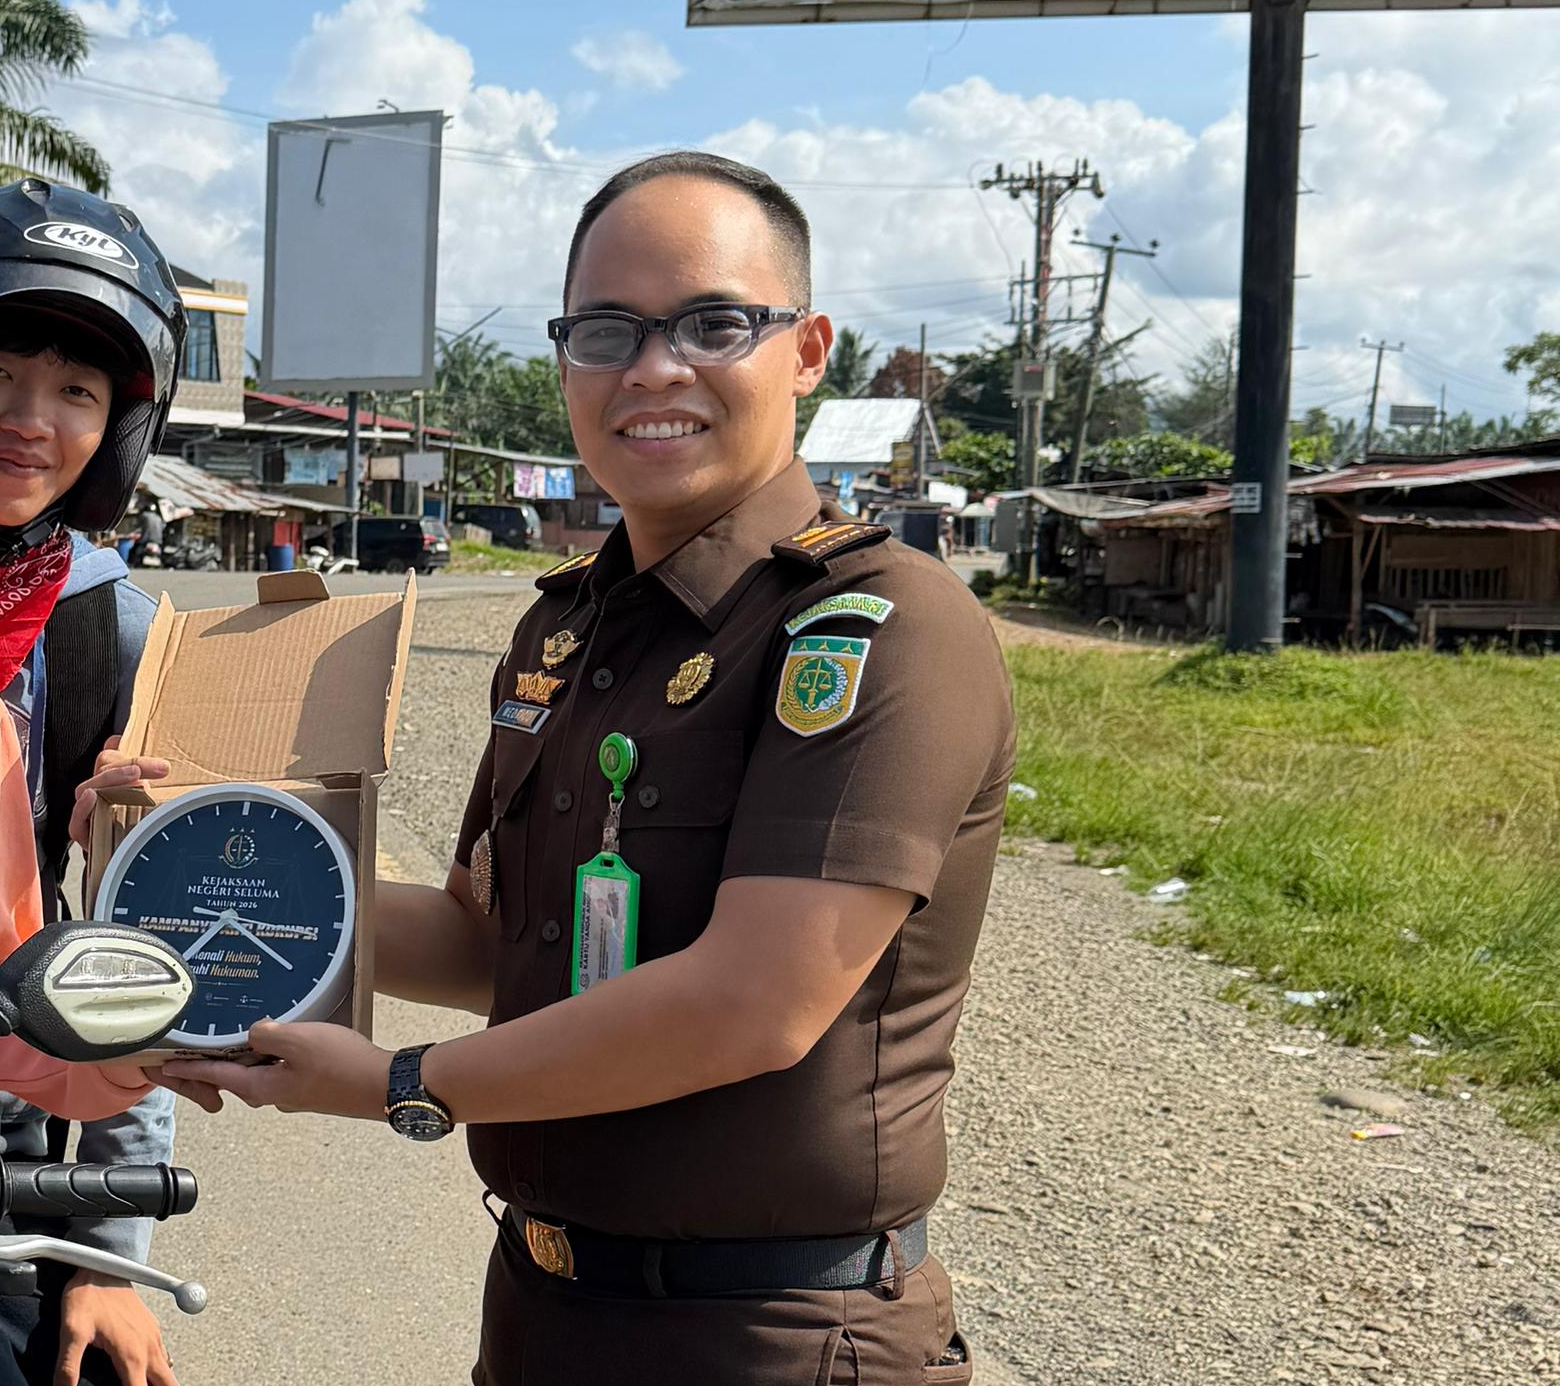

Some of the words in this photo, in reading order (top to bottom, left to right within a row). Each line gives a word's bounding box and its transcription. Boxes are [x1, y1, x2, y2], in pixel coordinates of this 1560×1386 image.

[202, 876, 266, 888] KEJAKSAAN
[187, 885, 231, 897] NEGERI
[234, 887, 280, 899] SELUMA
[206, 899, 236, 908] TAHUN
[238, 900, 258, 909] 2026
[192, 950, 225, 962] enali
[225, 951, 262, 965] Hukum,
[210, 965, 260, 979] Hukuman.
